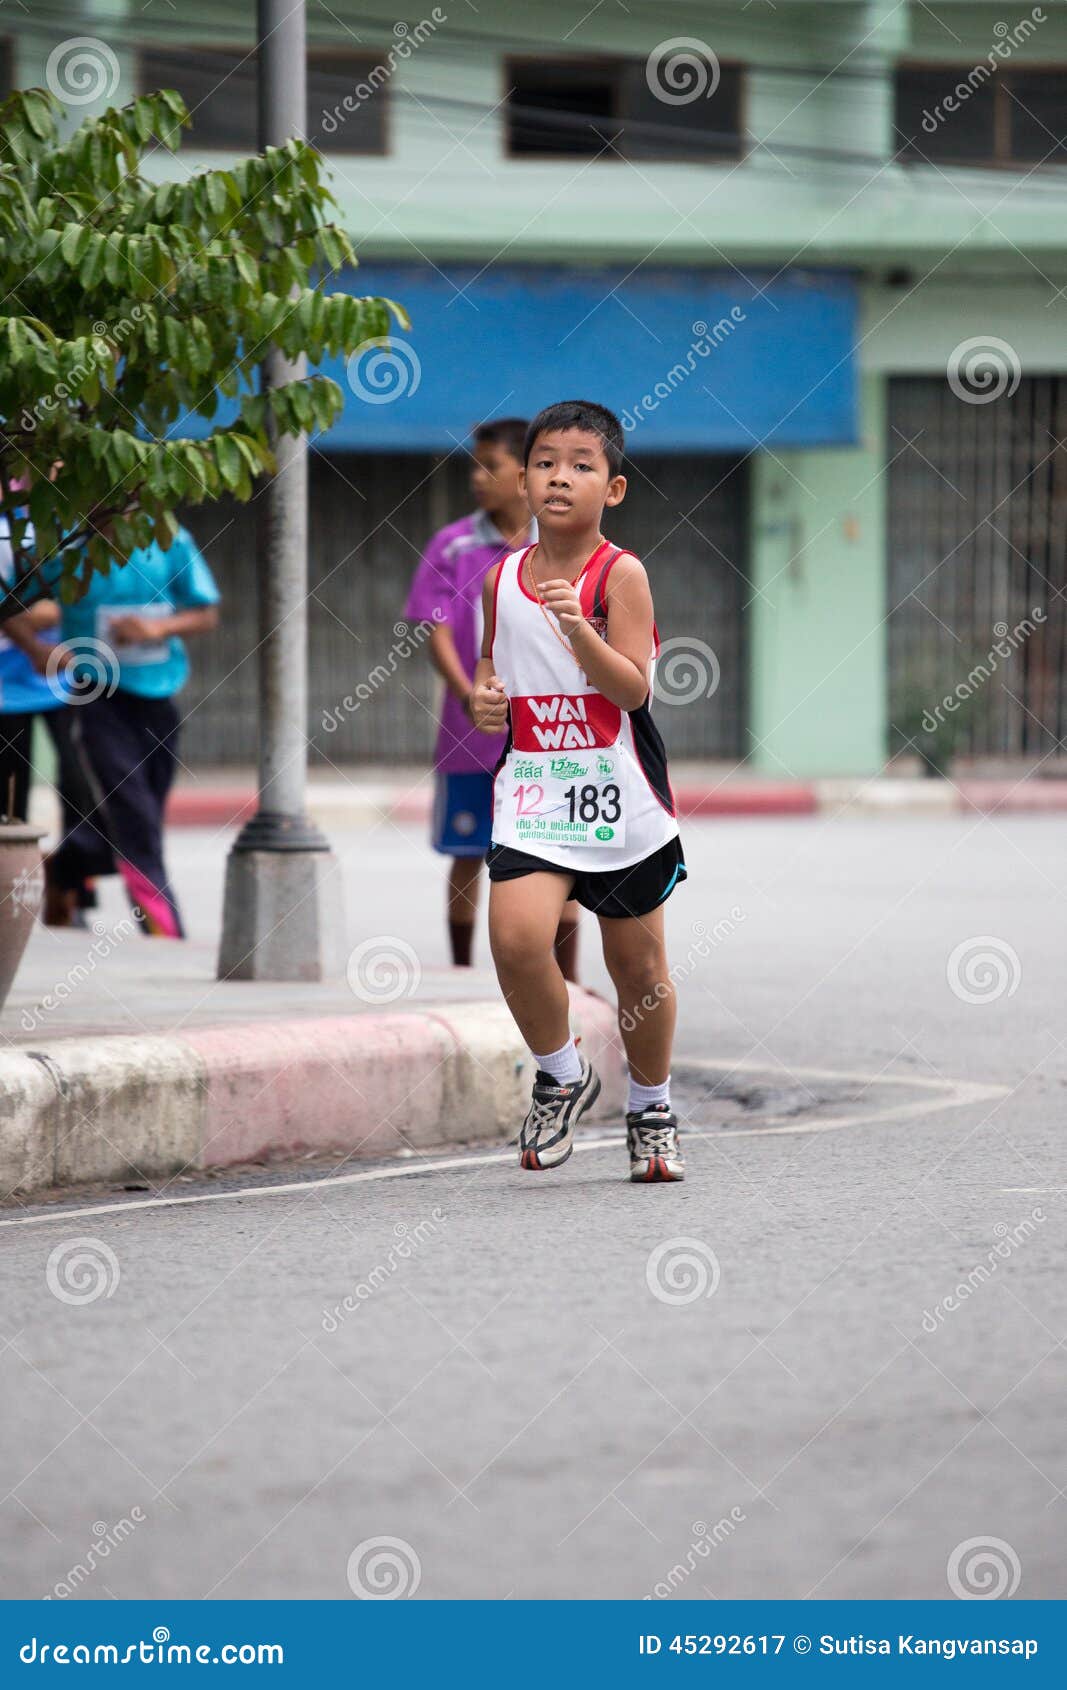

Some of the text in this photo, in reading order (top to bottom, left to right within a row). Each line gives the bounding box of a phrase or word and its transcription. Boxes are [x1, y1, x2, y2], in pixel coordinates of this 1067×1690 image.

[527, 697, 587, 723] WAI
[532, 724, 596, 750] WAI
[513, 784, 622, 824] 12 183
